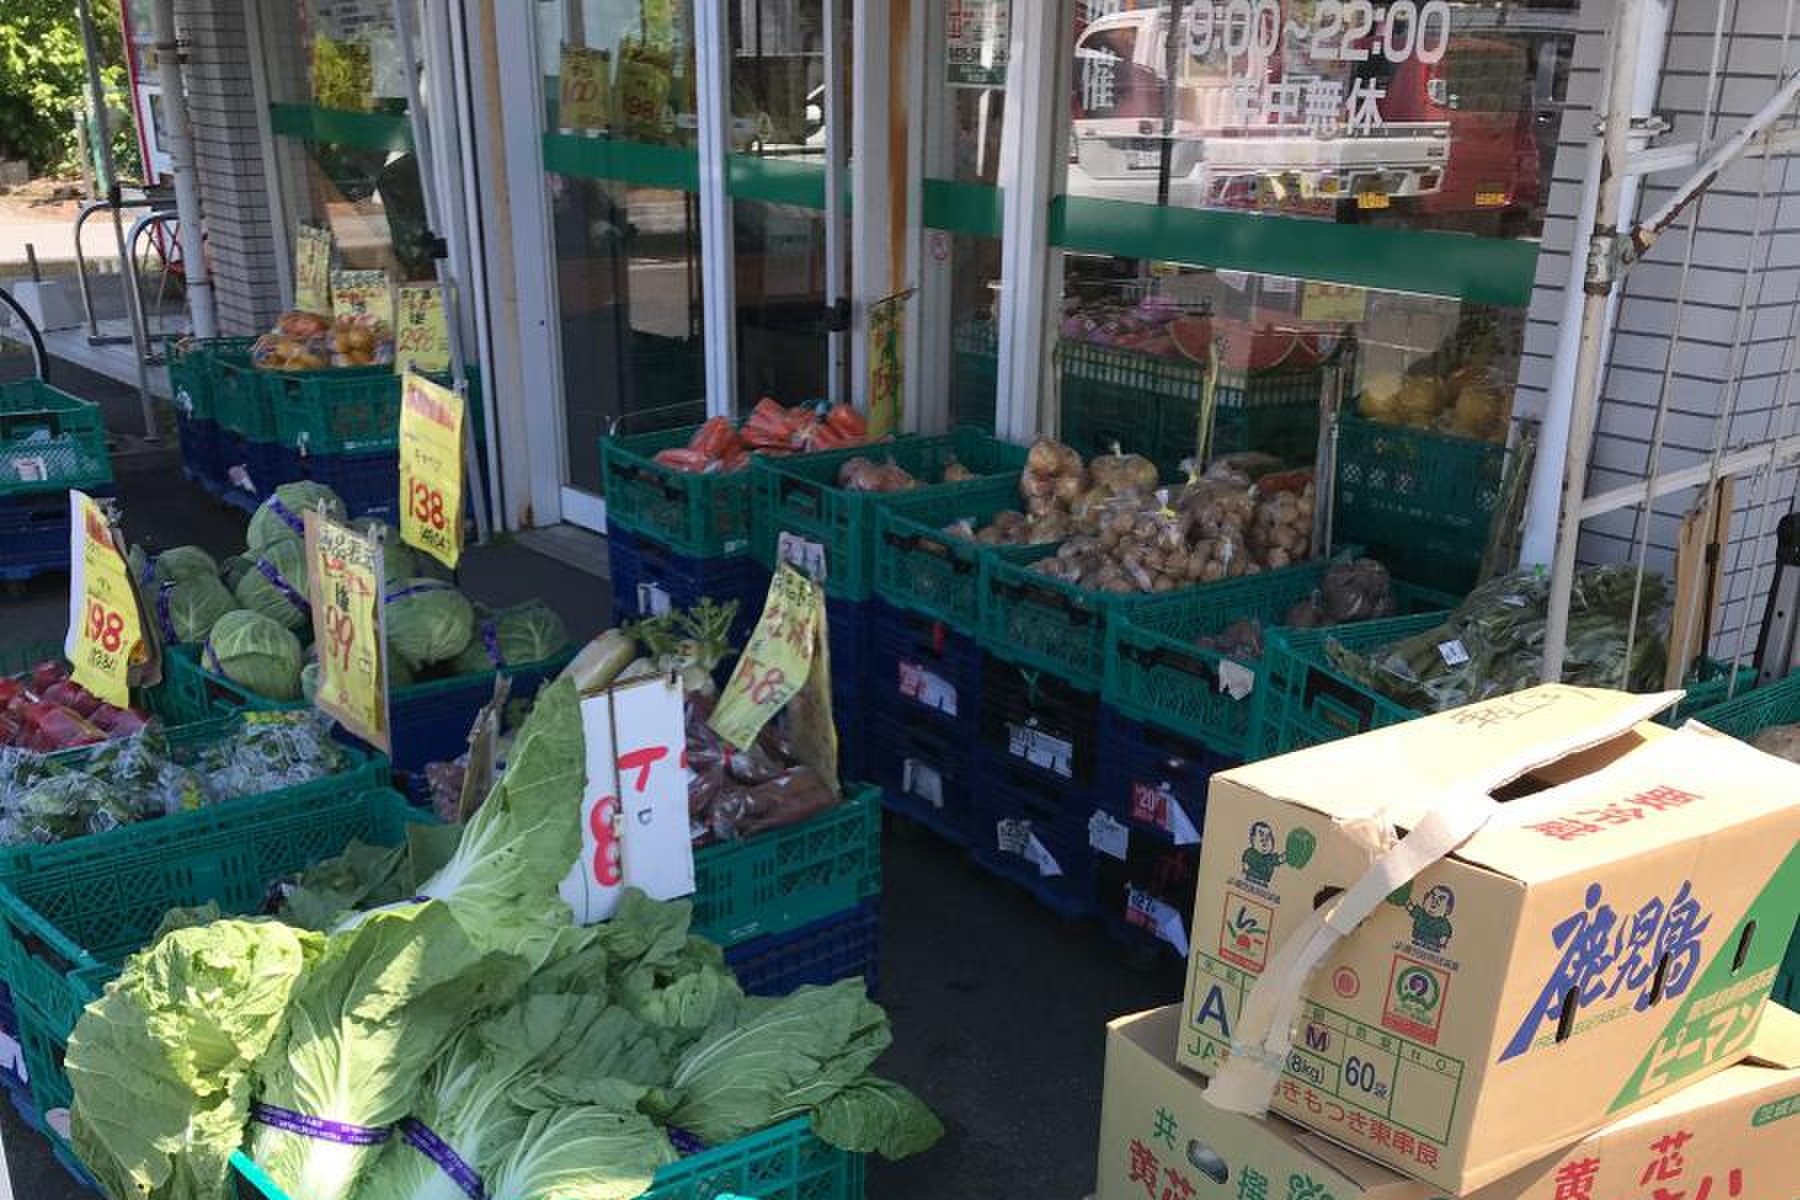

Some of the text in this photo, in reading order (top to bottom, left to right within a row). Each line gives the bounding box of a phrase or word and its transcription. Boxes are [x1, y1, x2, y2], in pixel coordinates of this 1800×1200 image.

[1497, 880, 1713, 1063] 鹿児島
[1195, 983, 1231, 1038] A
[1305, 1023, 1330, 1053] M
[1274, 1079, 1441, 1170] きもつき東串良
